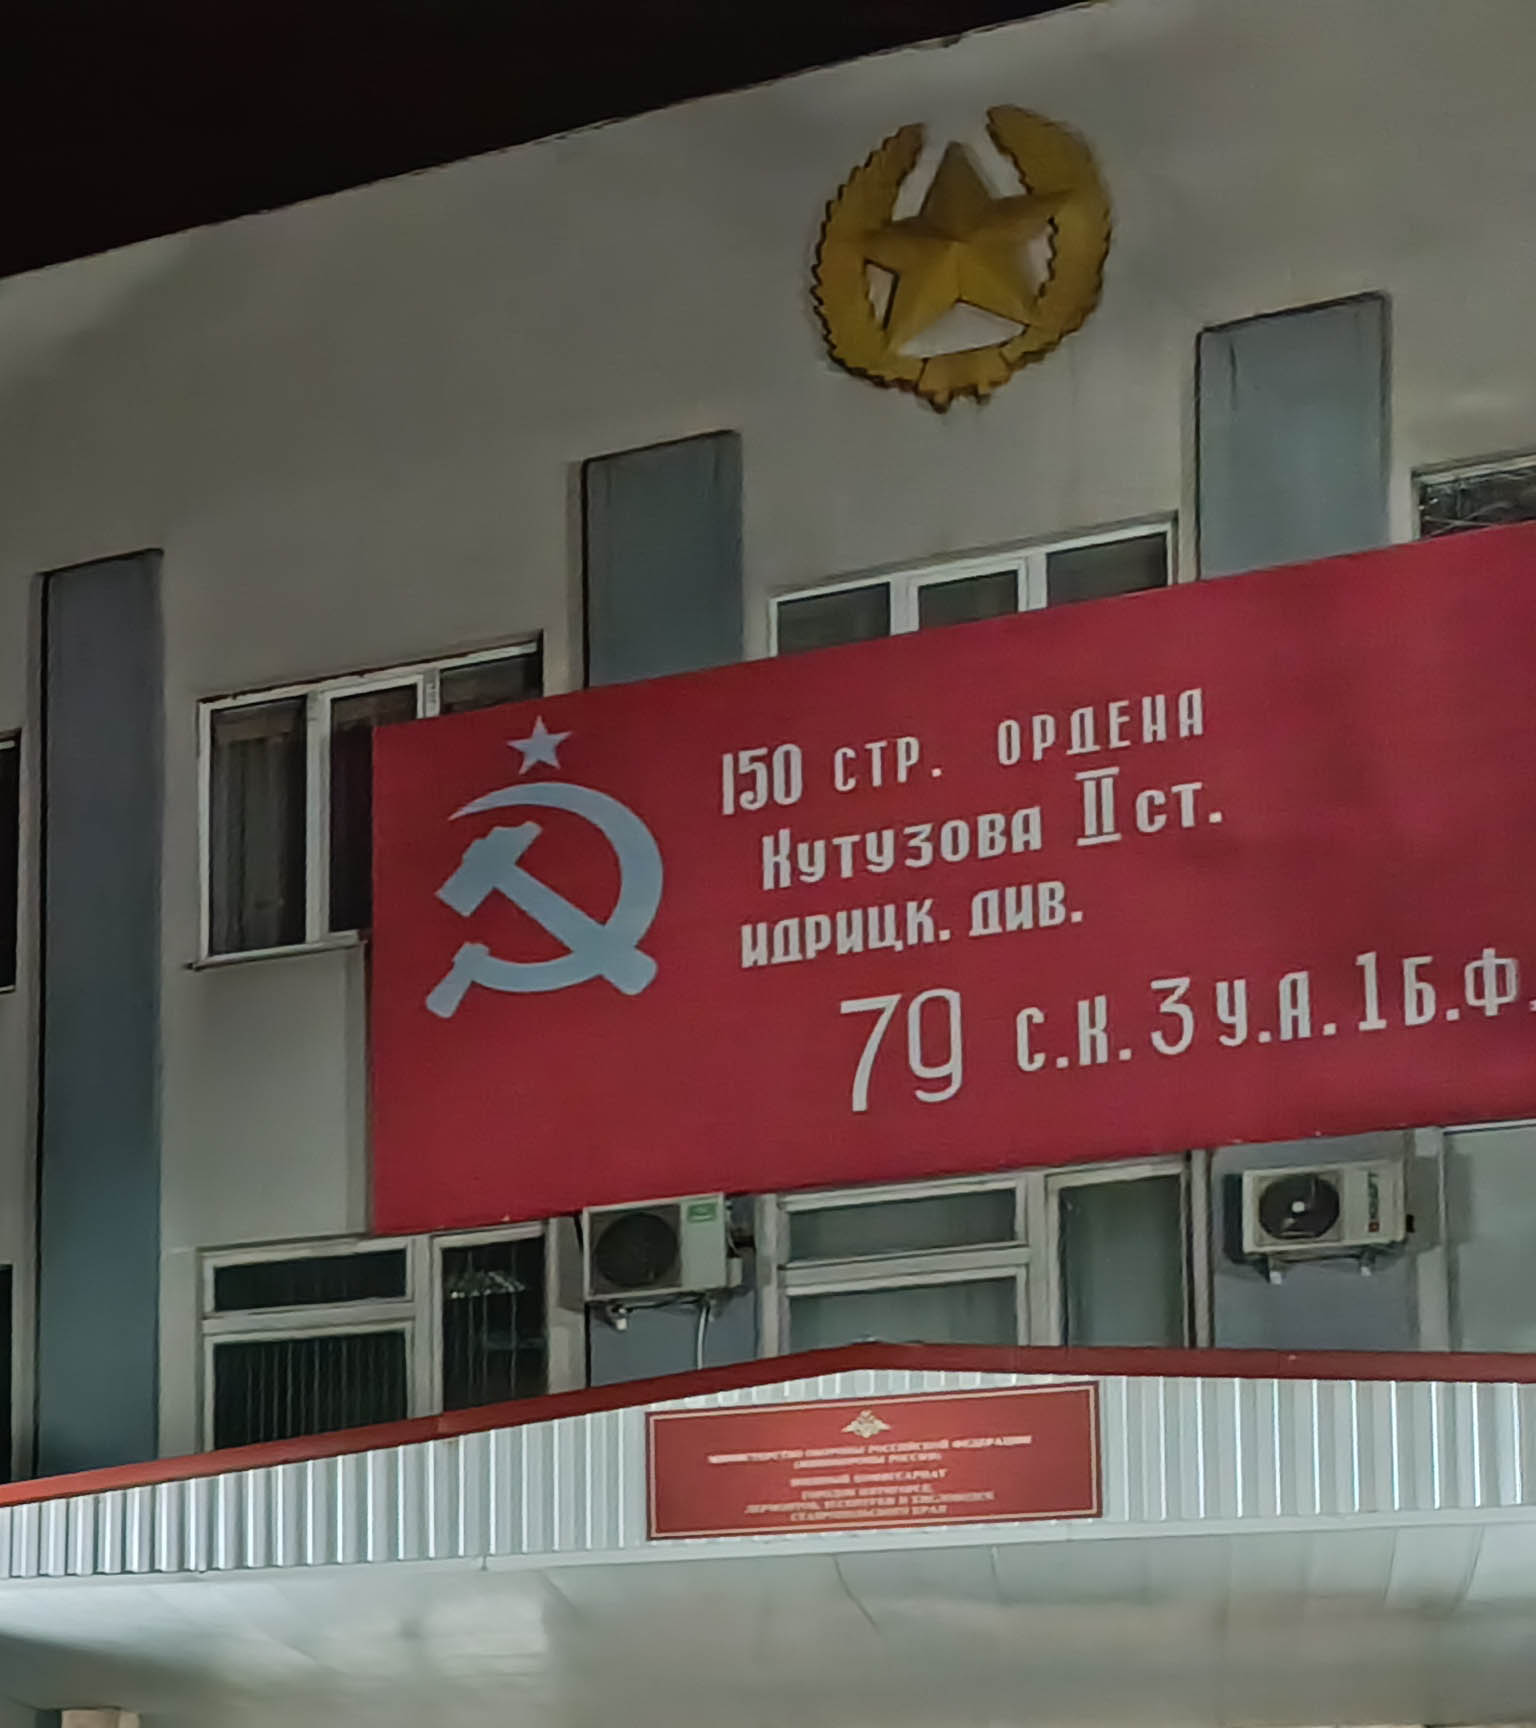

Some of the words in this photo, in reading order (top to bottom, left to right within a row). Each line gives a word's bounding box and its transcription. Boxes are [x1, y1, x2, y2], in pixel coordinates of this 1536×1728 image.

[723, 743, 803, 815] 150
[998, 688, 1203, 765] ОРДЕНА
[840, 988, 963, 1112] 79
[1150, 977, 1194, 1055] 3
[1356, 952, 1387, 1031] 1
